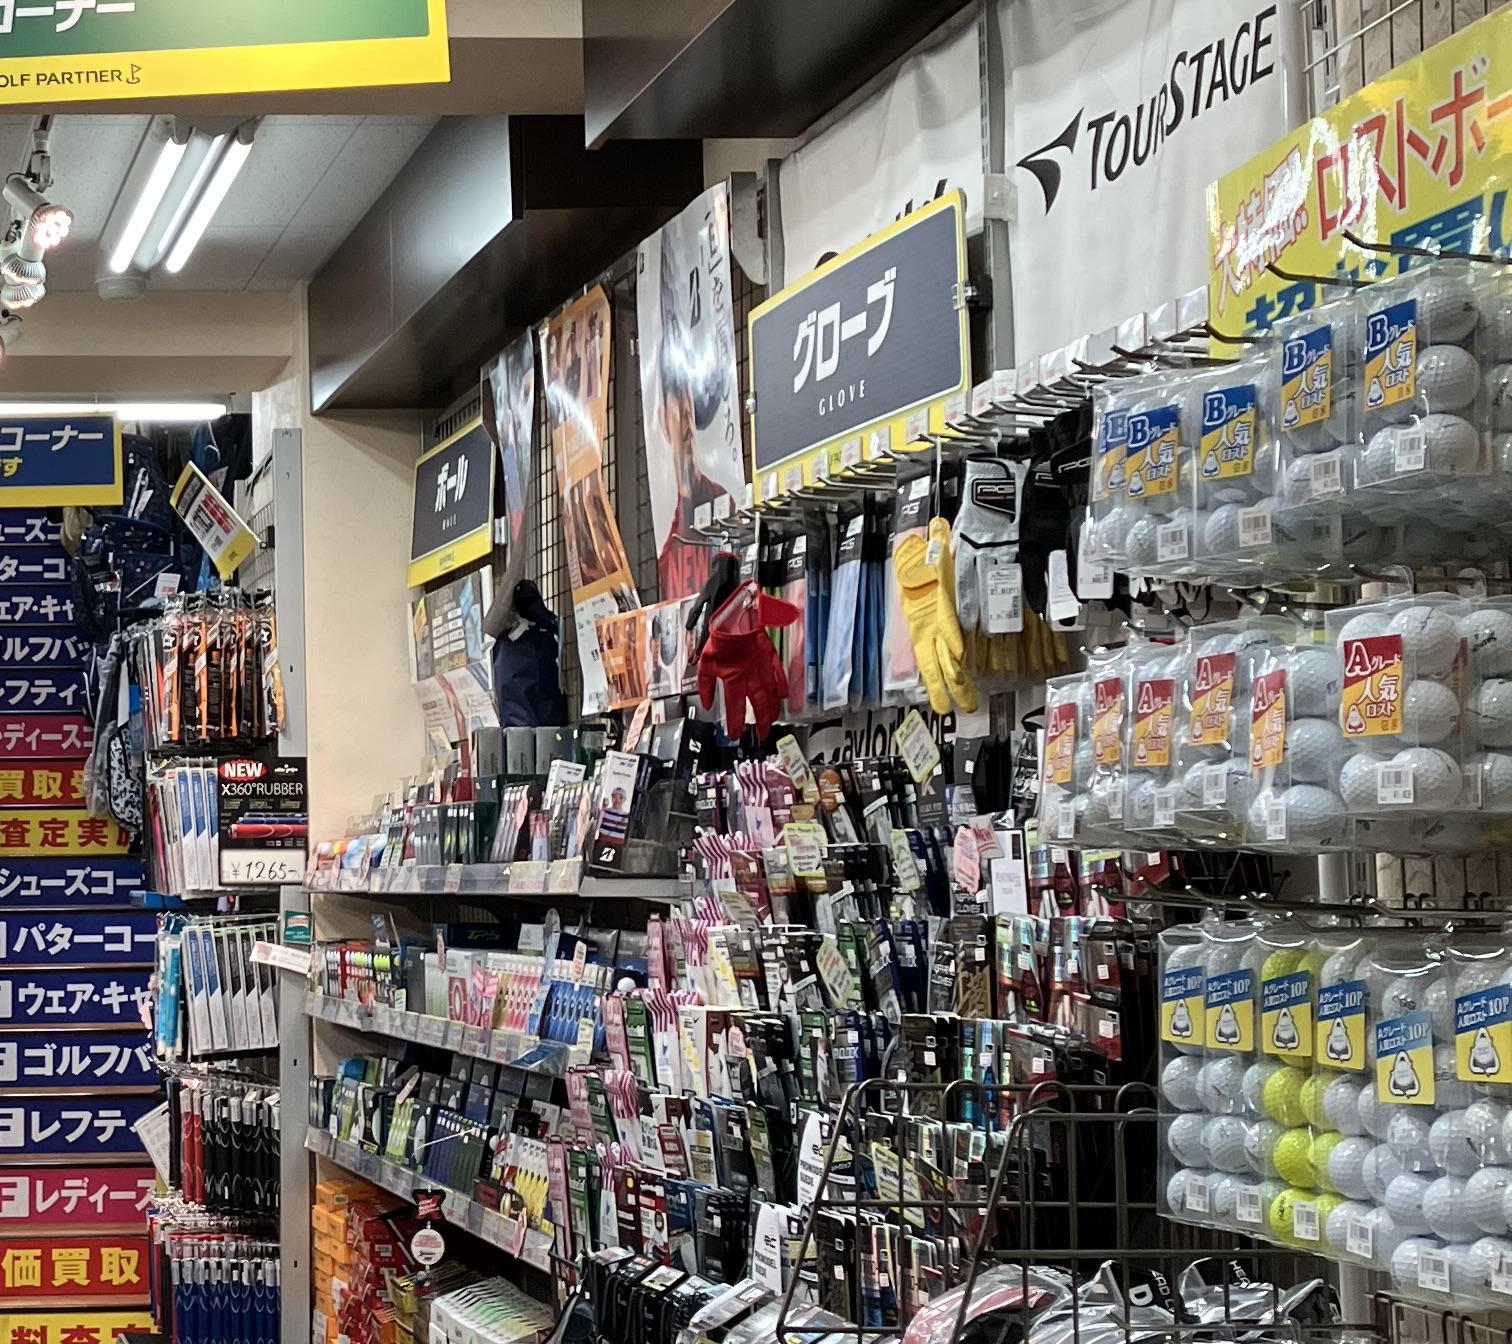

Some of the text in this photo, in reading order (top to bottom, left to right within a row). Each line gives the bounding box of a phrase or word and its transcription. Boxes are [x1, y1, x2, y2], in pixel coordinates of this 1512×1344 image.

[36, 67, 123, 86] PARTNER
[1087, 5, 1277, 191] TOURSTAGE
[793, 267, 897, 394] グローブ
[1376, 342, 1413, 378] 人気
[1293, 364, 1328, 399] 人気
[819, 382, 868, 416] GLOVE
[1215, 420, 1251, 452] 人気
[1140, 441, 1175, 471] 人気
[1358, 669, 1400, 703] 人気
[1367, 701, 1396, 717] ロスト
[225, 763, 263, 777] NEW
